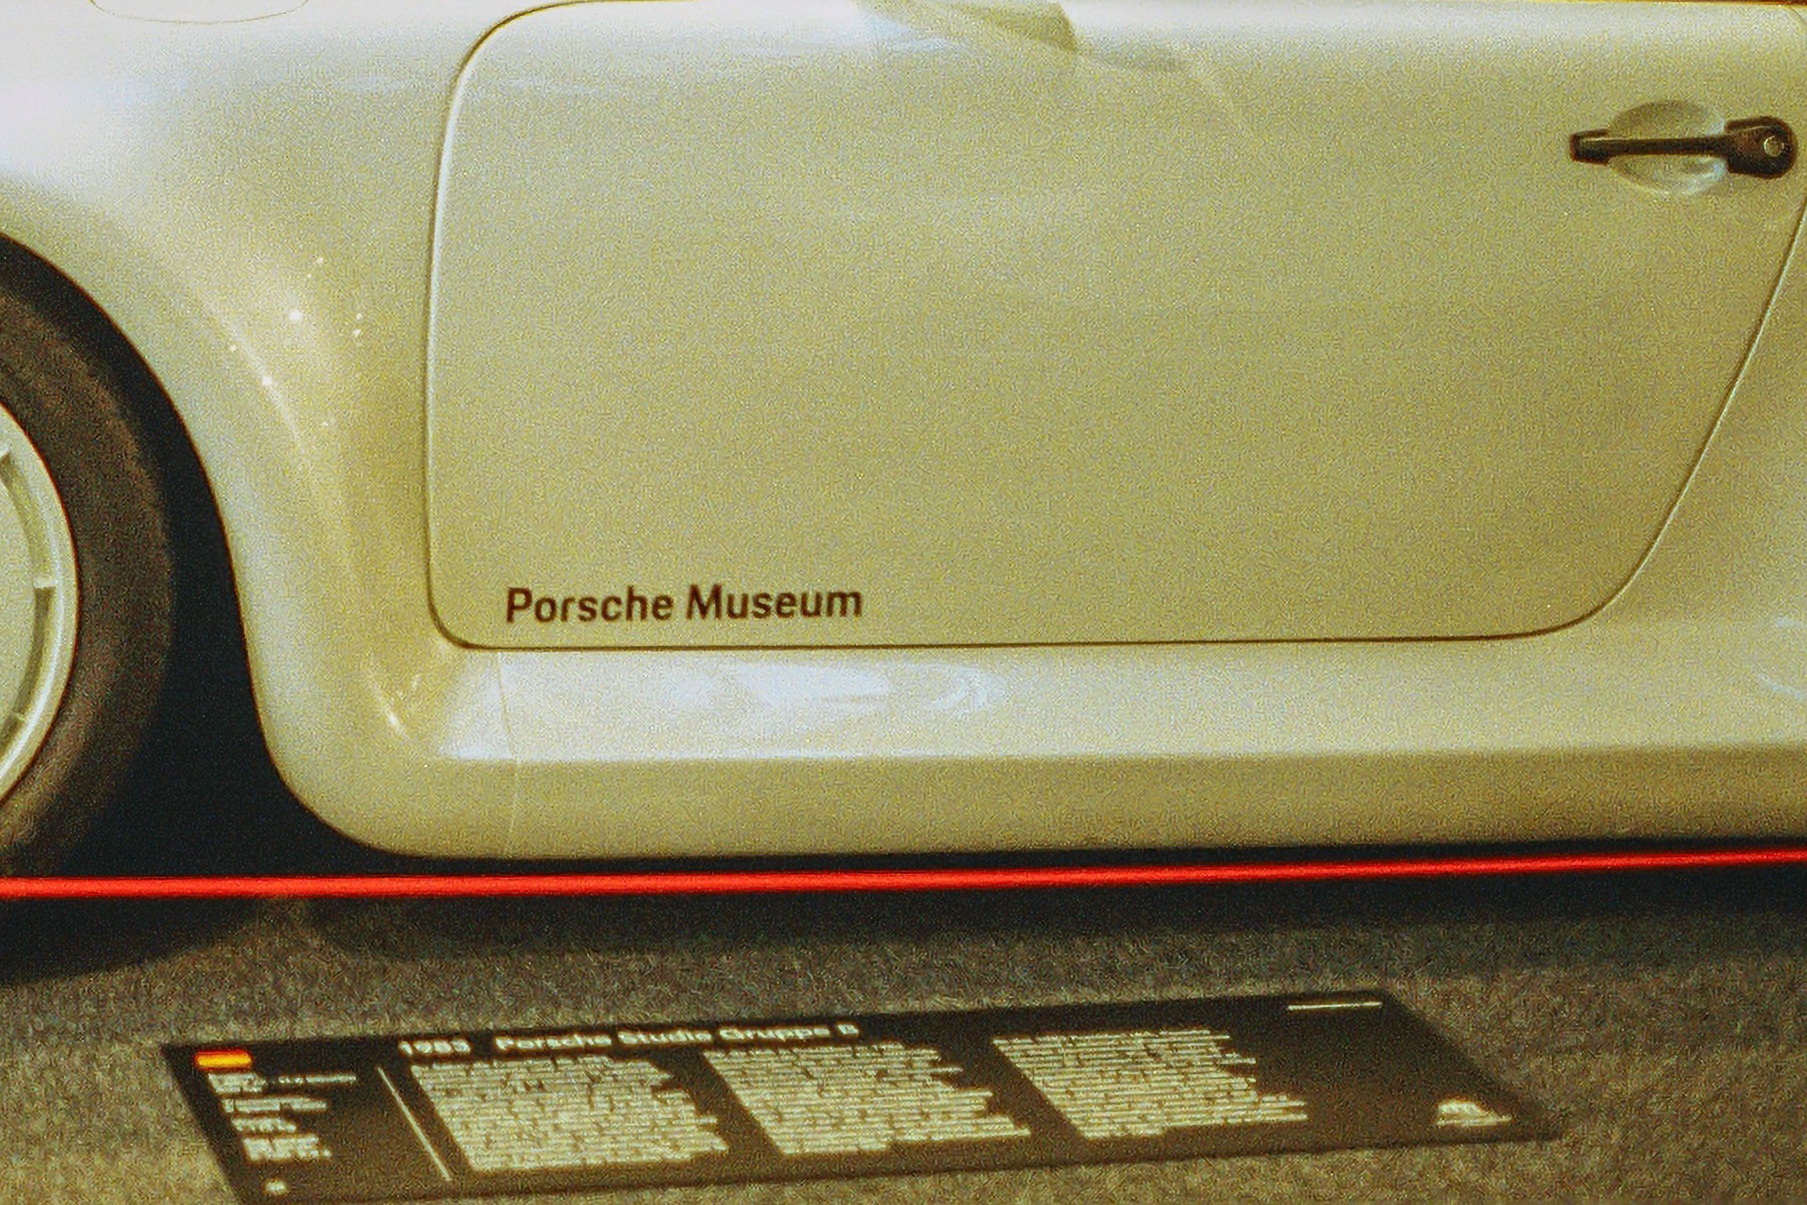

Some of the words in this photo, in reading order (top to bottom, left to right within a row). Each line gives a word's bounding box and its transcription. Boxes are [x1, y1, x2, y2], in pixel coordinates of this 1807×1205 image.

[506, 584, 675, 624] Porsche
[686, 583, 864, 621] Museum
[494, 1033, 613, 1051] Porsche
[718, 1025, 831, 1043] Gruppe
